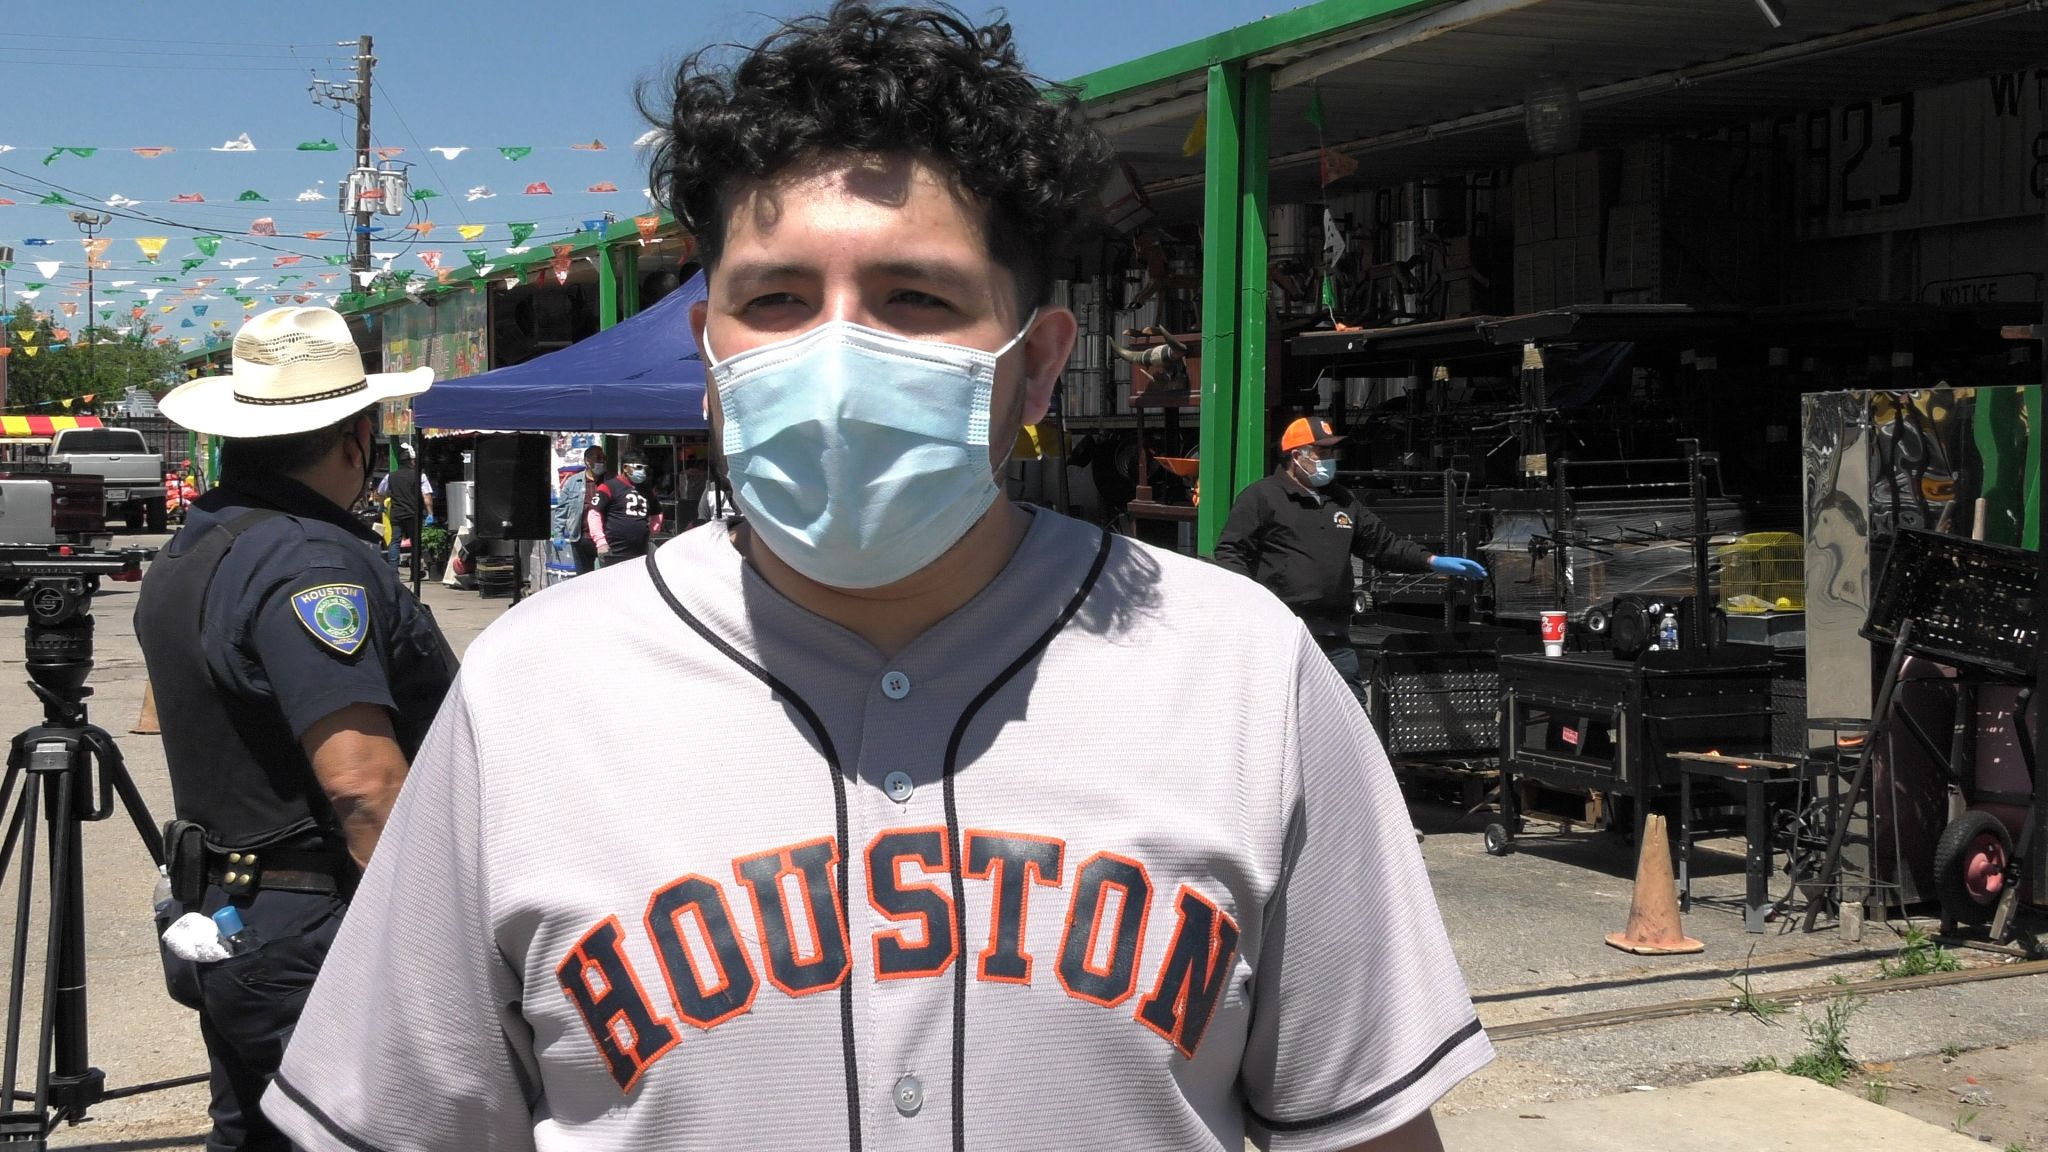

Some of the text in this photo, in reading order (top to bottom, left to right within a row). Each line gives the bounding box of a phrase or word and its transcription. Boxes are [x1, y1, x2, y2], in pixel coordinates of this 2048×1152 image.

[1940, 283, 1998, 305] NOTICE
[625, 493, 648, 516] 23
[300, 587, 358, 604] HOUSTON
[555, 826, 1241, 1094] HOUSTON
